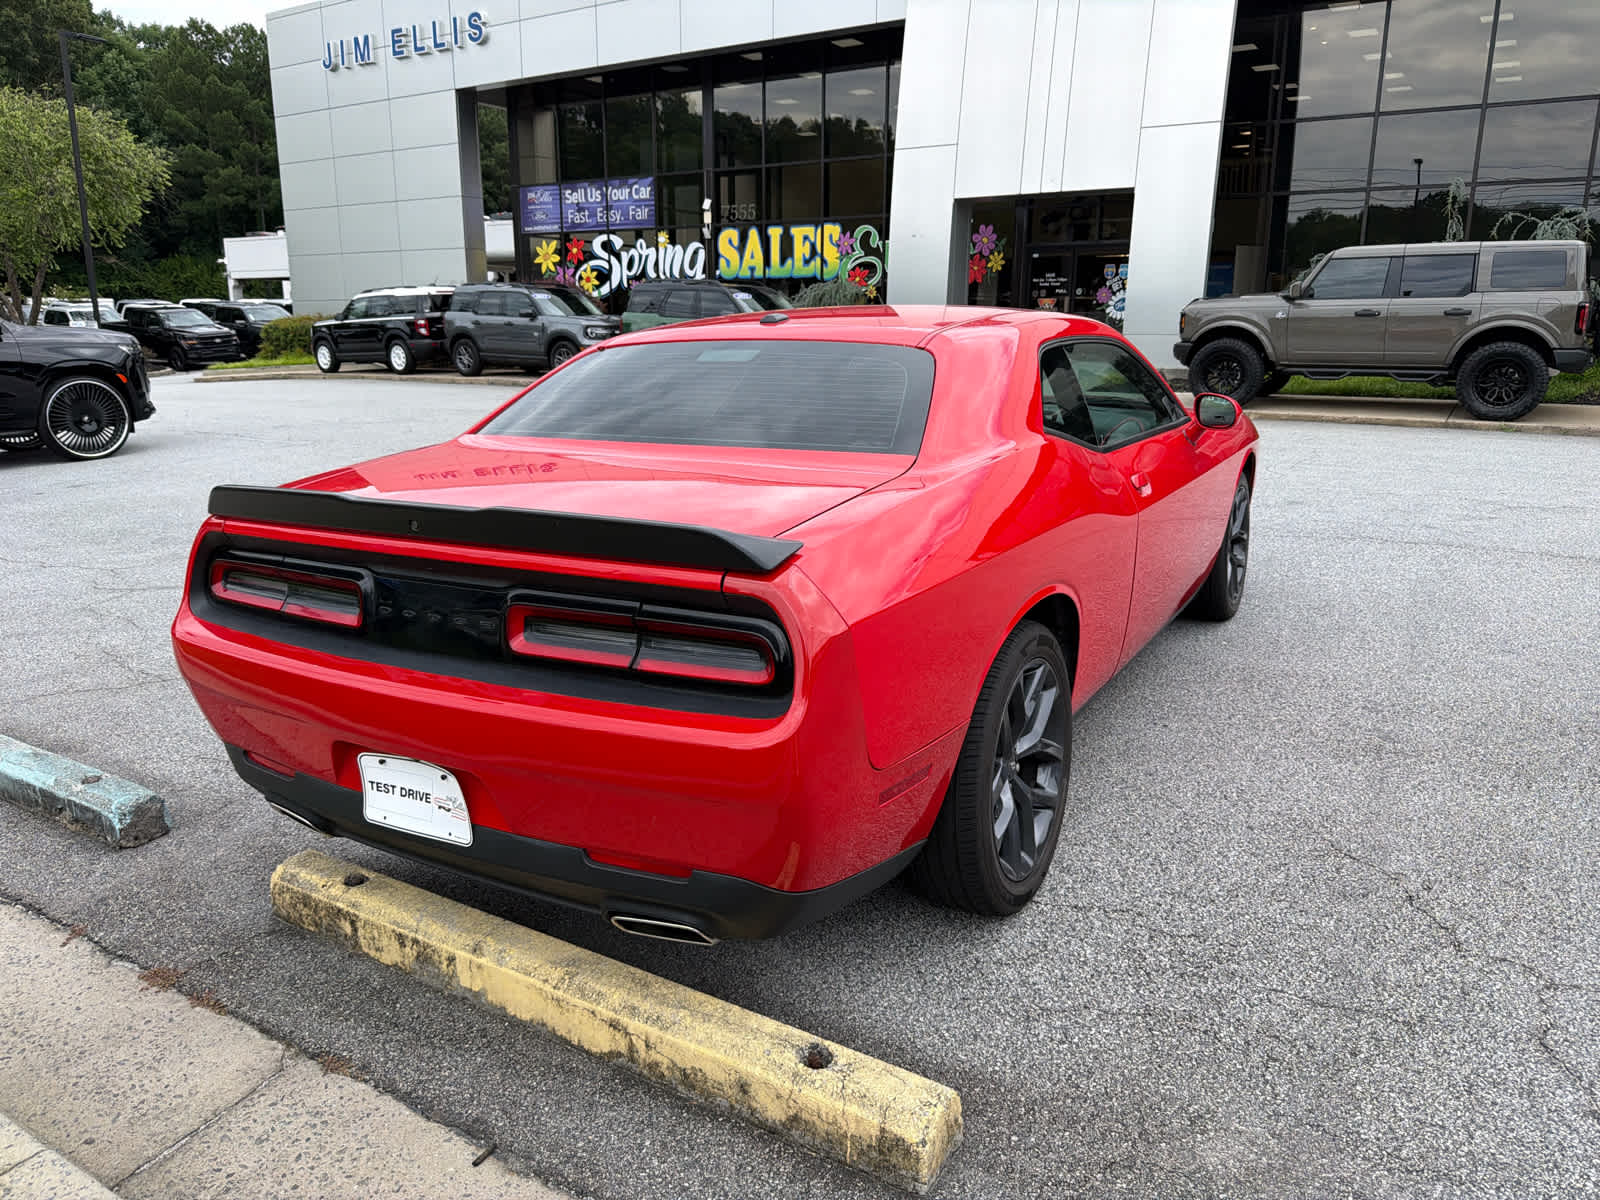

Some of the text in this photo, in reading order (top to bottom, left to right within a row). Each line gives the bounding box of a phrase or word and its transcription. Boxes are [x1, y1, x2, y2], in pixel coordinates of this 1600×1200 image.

[322, 11, 485, 70] JIM ELLIS
[565, 188, 586, 204] Sell
[587, 187, 601, 202] Us
[603, 185, 630, 201] Your
[632, 184, 651, 200] Car
[568, 208, 592, 224] Fast.
[629, 205, 649, 220] Fair
[575, 234, 706, 298] Spring
[717, 222, 842, 281] SALES
[368, 780, 397, 796] TEST
[399, 787, 432, 804] DRIVE
